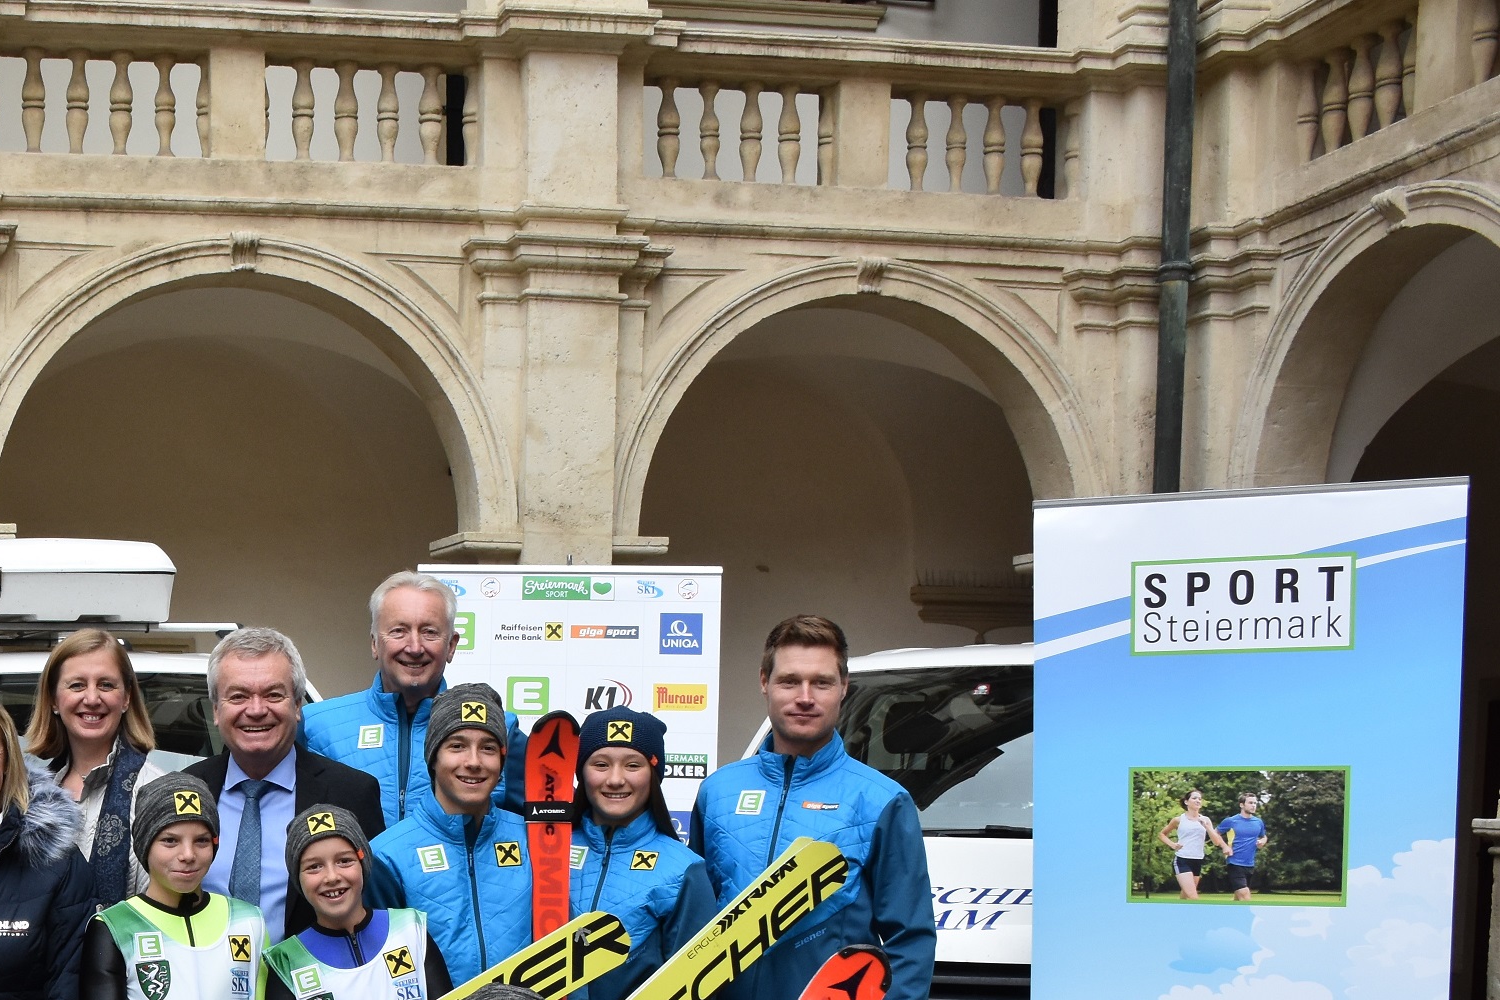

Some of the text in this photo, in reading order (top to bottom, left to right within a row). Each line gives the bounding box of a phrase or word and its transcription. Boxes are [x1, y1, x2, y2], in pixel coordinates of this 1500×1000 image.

[523, 577, 589, 595] Steiermark
[545, 590, 569, 598] SPORT
[1143, 565, 1344, 609] SPORT
[500, 624, 543, 632] Raiffeisen
[579, 627, 637, 637] giga sport
[1142, 606, 1343, 644] Steiermark
[494, 633, 543, 641] Meine Bank
[661, 638, 700, 649] UNIQA
[512, 681, 544, 711] E
[584, 685, 618, 710] K1
[656, 686, 705, 709] Murauer
[821, 803, 839, 811] sport
[727, 855, 799, 923] XTRAFAT
[686, 926, 722, 960] EAGLE
[231, 977, 249, 992] SKI
